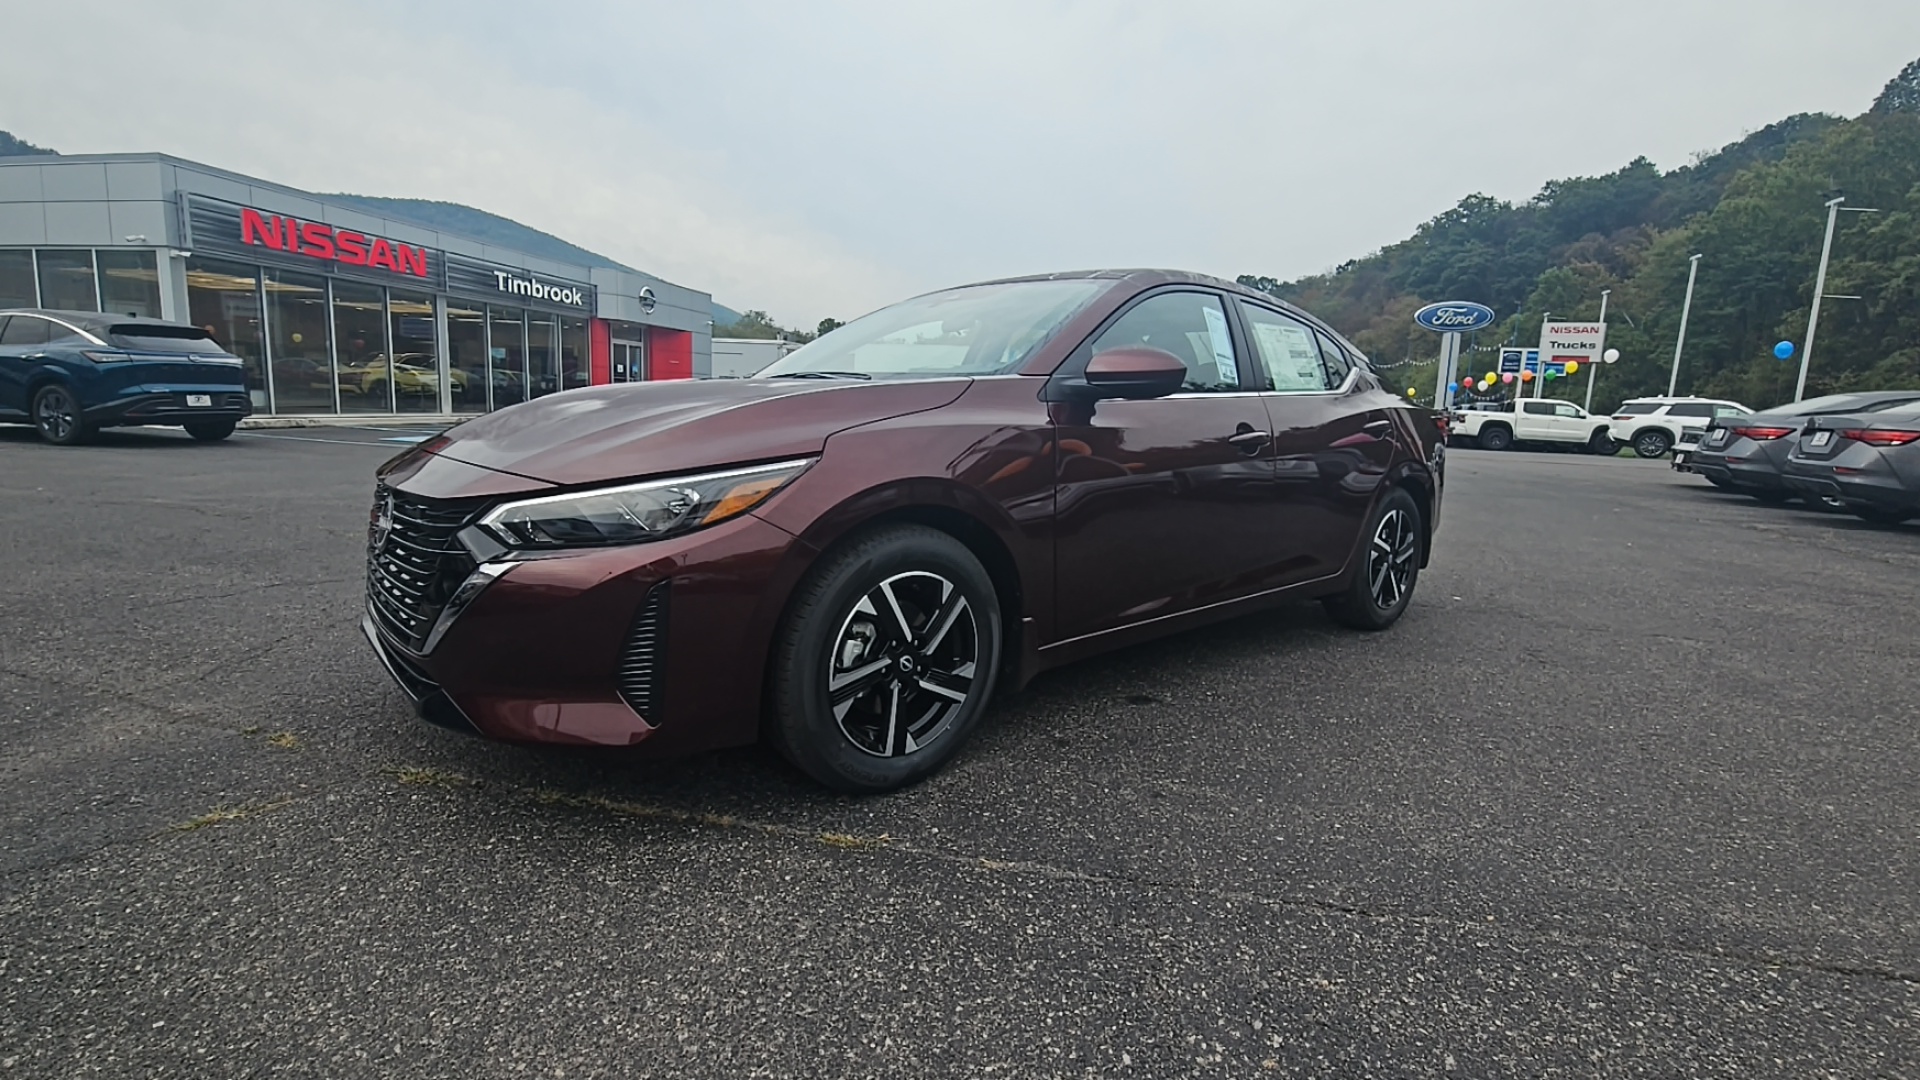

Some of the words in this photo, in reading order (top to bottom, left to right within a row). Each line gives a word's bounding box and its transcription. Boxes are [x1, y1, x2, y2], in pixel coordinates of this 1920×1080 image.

[240, 207, 427, 277] NISSAN
[493, 270, 583, 306] Timbrook
[1431, 307, 1479, 326] Ford
[1549, 326, 1600, 334] NISSAN
[1549, 340, 1596, 349] Trucks
